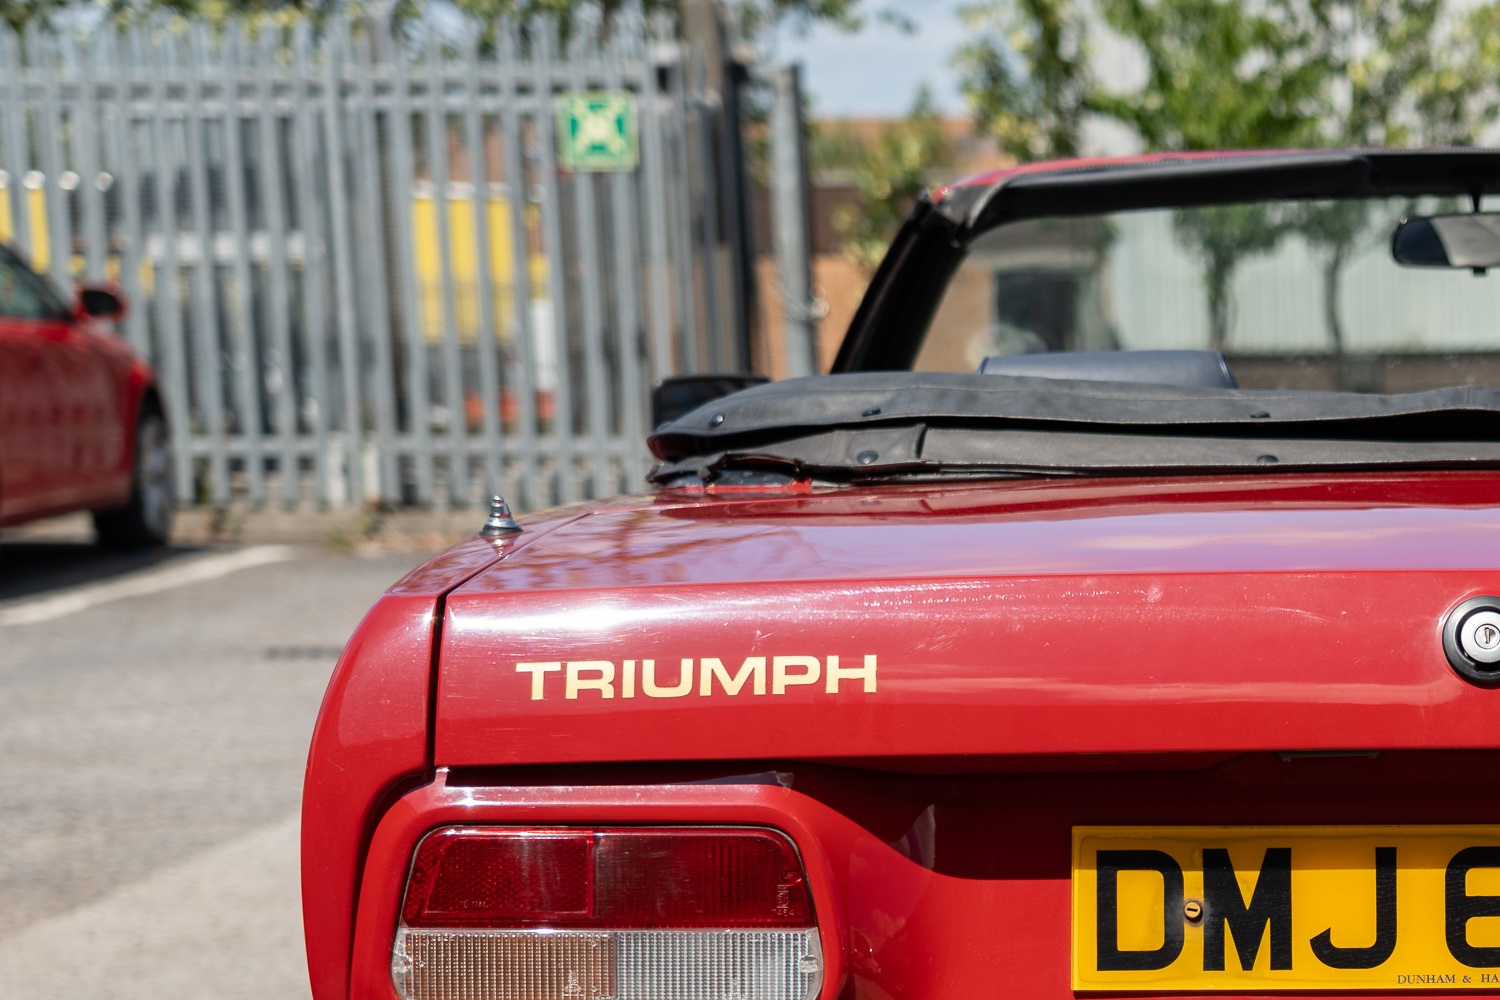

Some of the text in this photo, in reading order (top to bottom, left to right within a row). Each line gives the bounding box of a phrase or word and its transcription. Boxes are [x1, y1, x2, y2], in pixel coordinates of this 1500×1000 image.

[515, 654, 878, 700] TRIUMPH
[1096, 846, 1398, 972] DMJ
[1396, 973, 1456, 984] DUNHAM
[1462, 974, 1472, 984] &
